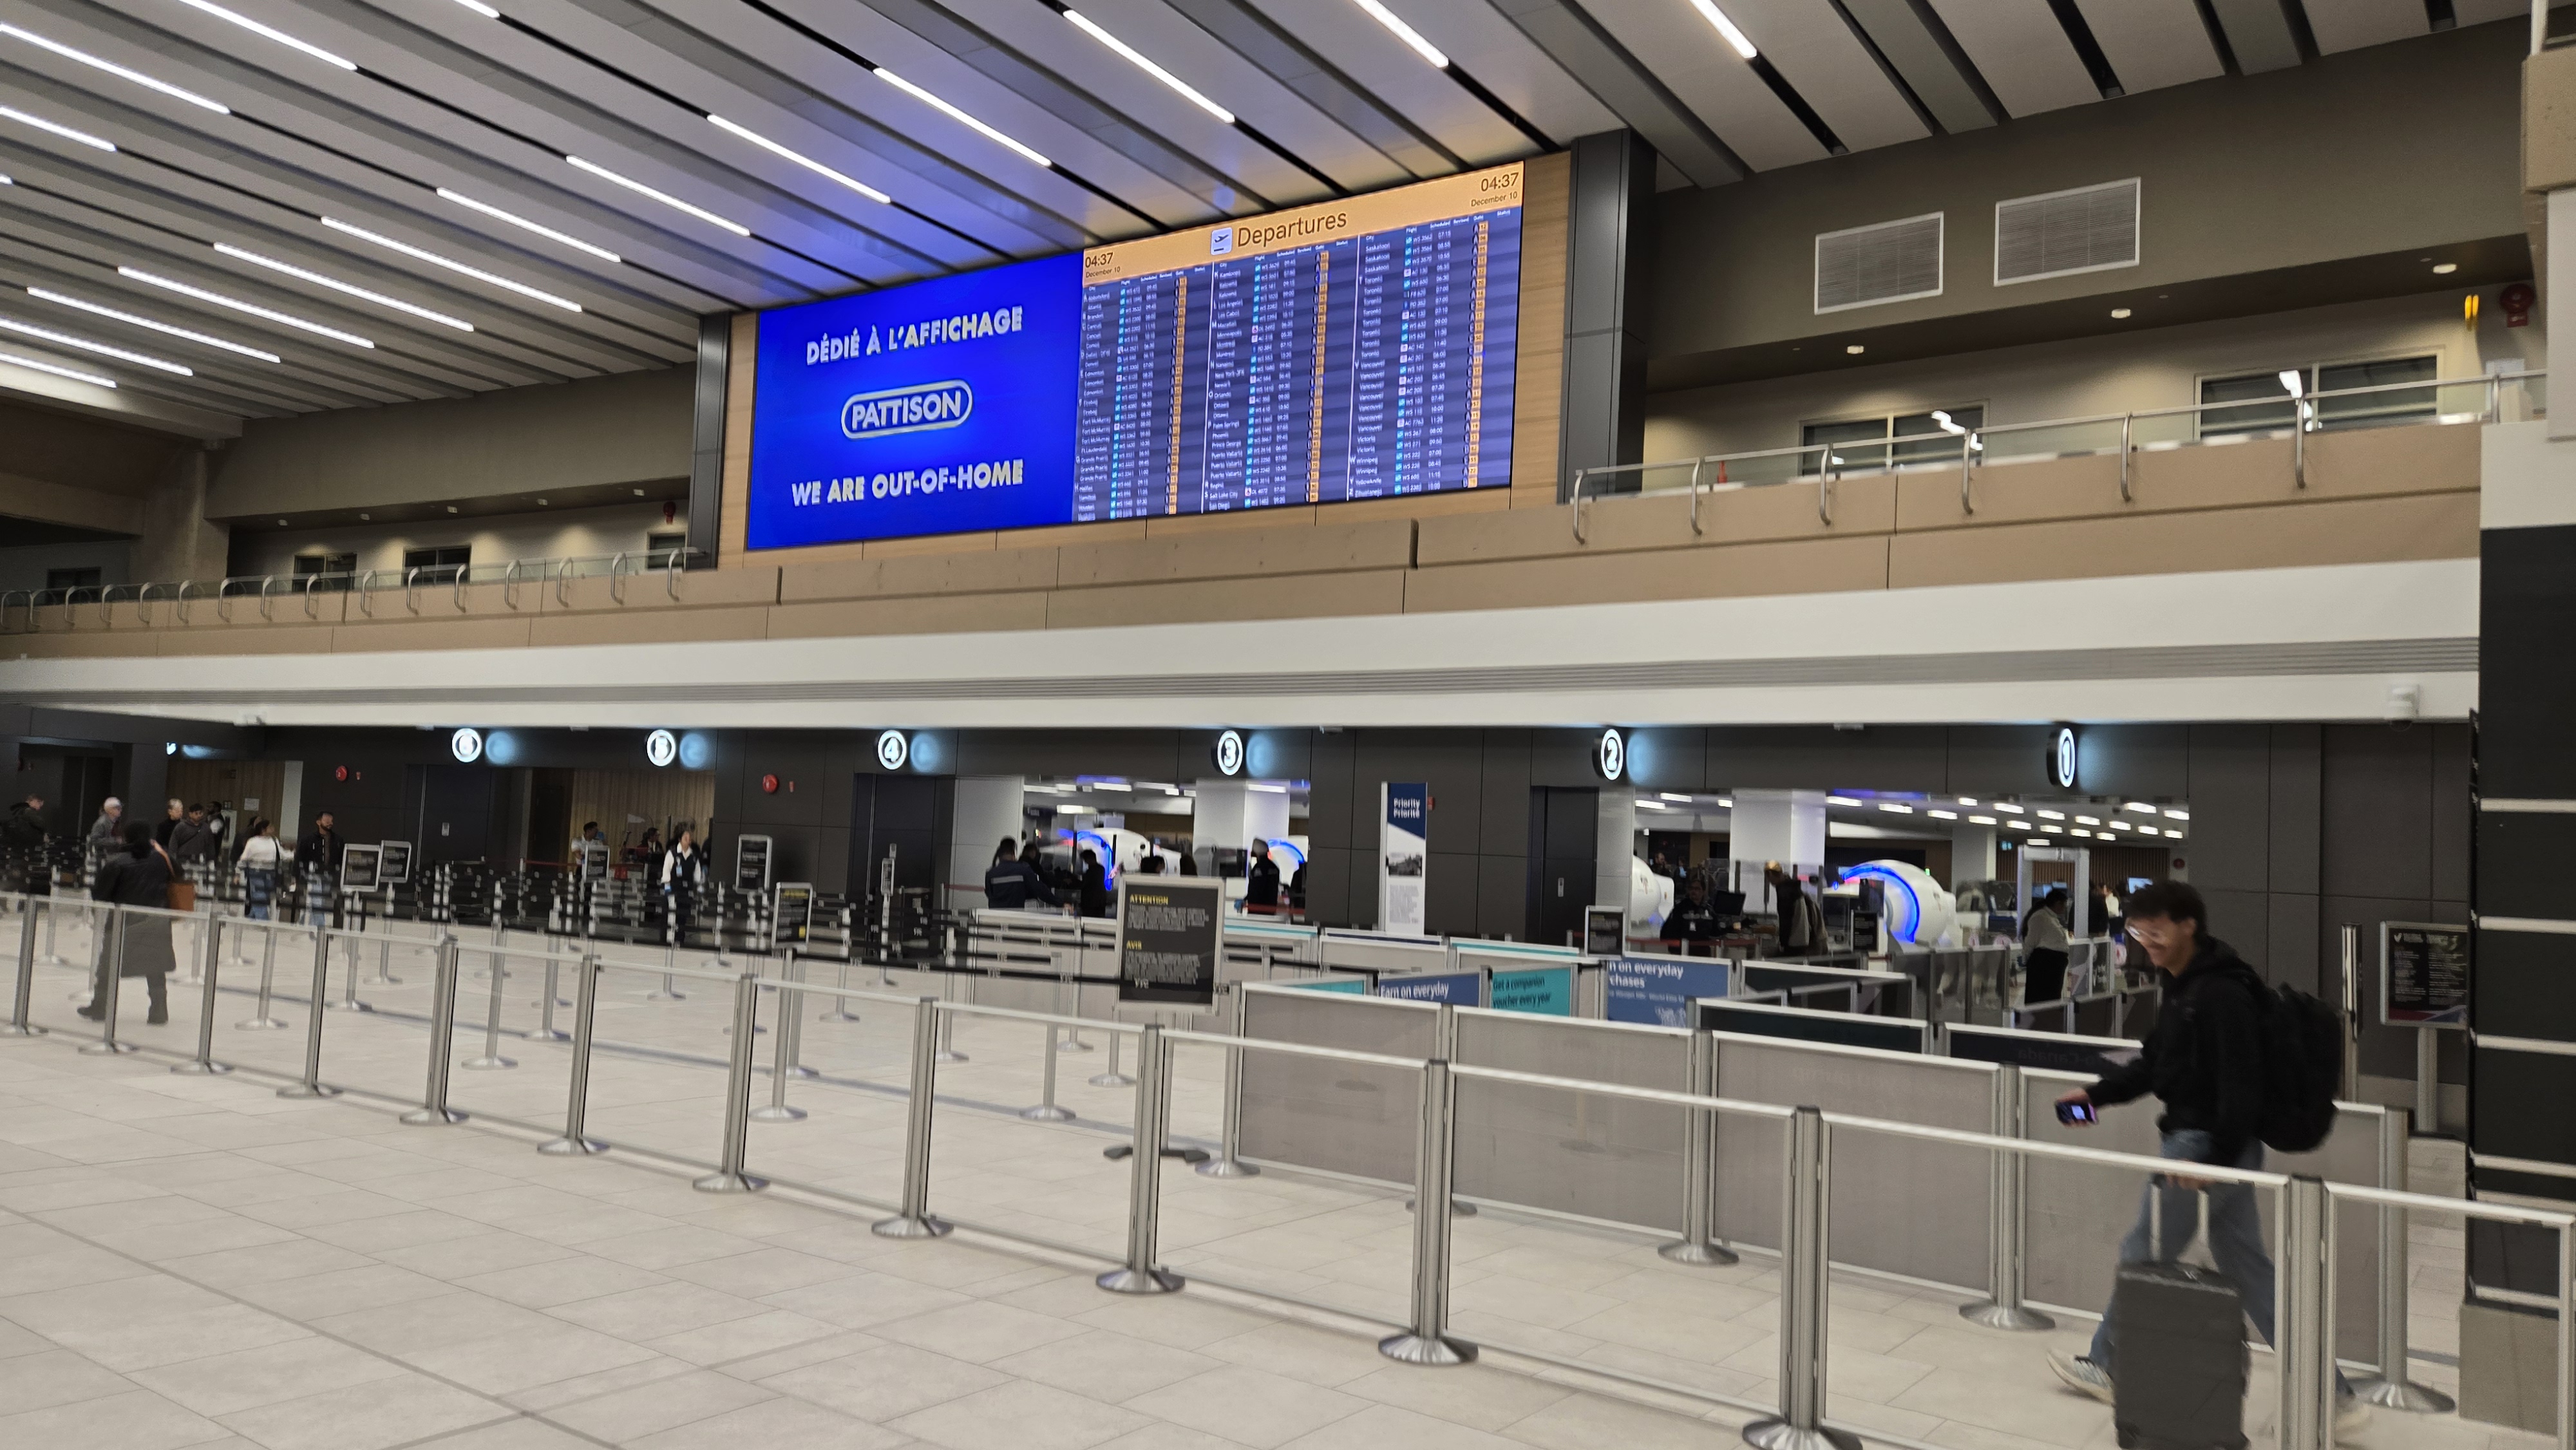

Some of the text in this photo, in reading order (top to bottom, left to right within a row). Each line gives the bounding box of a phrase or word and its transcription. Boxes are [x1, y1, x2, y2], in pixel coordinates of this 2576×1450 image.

[1481, 173, 1519, 193] 04:37
[1470, 193, 1506, 207] December
[1237, 211, 1348, 247] Departures
[1084, 252, 1113, 268] 04:37
[1086, 268, 1112, 278] December
[806, 328, 860, 365] DÉDIÉ
[866, 325, 882, 355] À
[851, 390, 961, 431] PATTISON
[791, 458, 1024, 507] WE ARE OUT-OF-HOME
[885, 739, 899, 762] 4
[1224, 739, 1236, 767] 3
[1605, 739, 1618, 771] 2
[1393, 797, 1420, 809] Priority
[1393, 807, 1420, 819] Priorité
[1130, 894, 1168, 905] ATTENTION
[1126, 940, 1142, 950] AVIS
[1618, 961, 1632, 974] on
[1634, 963, 1684, 980] everyday
[1493, 977, 1504, 992] Get
[1511, 974, 1545, 992] companion
[1609, 974, 1645, 988] chases
[1381, 981, 1450, 1000] Earn on everyday
[1493, 992, 1551, 1009] voucher every year
